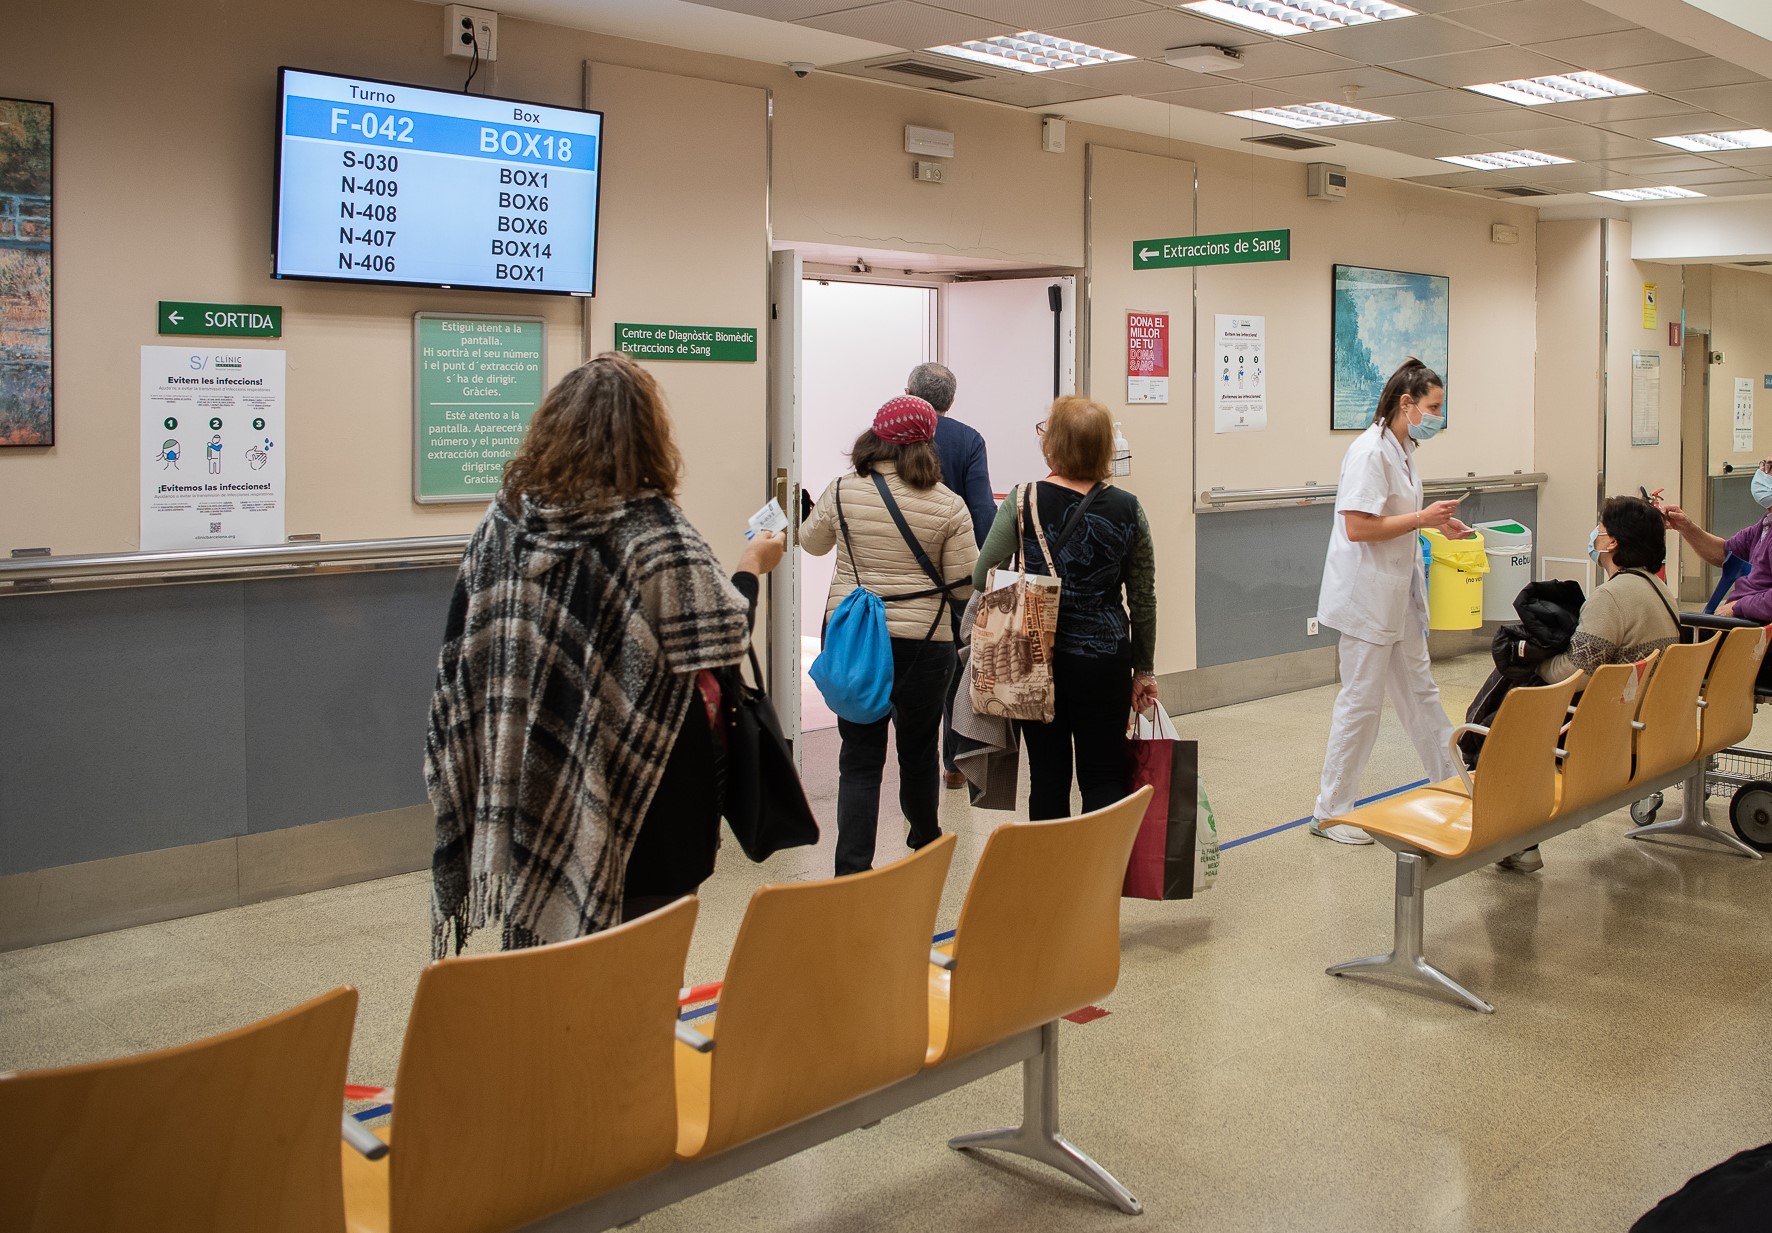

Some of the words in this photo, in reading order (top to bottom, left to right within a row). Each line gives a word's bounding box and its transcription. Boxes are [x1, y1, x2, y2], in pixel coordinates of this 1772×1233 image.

[350, 85, 395, 104] Turno
[514, 109, 540, 123] Box
[331, 108, 414, 143] F-042
[480, 128, 572, 162] BOX18
[343, 151, 398, 172] S-030
[500, 169, 548, 188] BOX1
[342, 176, 398, 197] N-409
[499, 192, 548, 212] BOX6
[341, 202, 397, 222] N-408
[498, 216, 548, 236] BOX6
[340, 227, 396, 248] N-407
[492, 240, 552, 259] BOX14
[1164, 242, 1229, 258] Extraccions
[1234, 239, 1248, 253] de
[1253, 238, 1281, 254] Sang
[339, 253, 395, 272] N-406
[496, 264, 544, 282] BOX1
[205, 312, 273, 329] SORTIDA
[1130, 316, 1153, 326] DONA
[1155, 318, 1164, 328] EL
[442, 322, 474, 333] Estigui
[477, 324, 502, 333] atent
[514, 324, 522, 333] la
[1130, 328, 1160, 338] MILLOR
[622, 328, 652, 339] Centre
[655, 329, 666, 339] de
[669, 330, 713, 342] Diagnòstic
[716, 332, 753, 342] Biomèdic
[461, 336, 502, 346] pantalla.
[1130, 339, 1142, 348] DE
[1143, 339, 1153, 348] TU
[424, 348, 434, 356] Hi
[437, 348, 469, 357] sortirà
[503, 349, 539, 359] número
[622, 342, 674, 353] Extraccions
[677, 344, 688, 353] de
[691, 345, 711, 356] Sang
[215, 355, 241, 363] CLÍNIC
[1130, 350, 1154, 360] DONA
[424, 361, 427, 369] i
[443, 362, 465, 372] punt
[1130, 360, 1153, 371] SANG
[473, 375, 483, 383] de
[487, 375, 516, 386] dirigir.
[463, 387, 501, 396] Gràcies.
[446, 411, 466, 420] Esté
[469, 412, 500, 420] atento
[512, 411, 519, 420] la
[429, 425, 471, 435] pantalla.
[474, 423, 522, 435] Aparecerá
[431, 438, 468, 446] número
[480, 437, 489, 446] el
[492, 438, 518, 448] punto
[428, 449, 478, 459] extracción
[482, 449, 511, 458] donde
[462, 462, 503, 472] dirigirse.
[464, 475, 501, 484] Gracias.
[158, 484, 202, 493] ¡Evitemos
